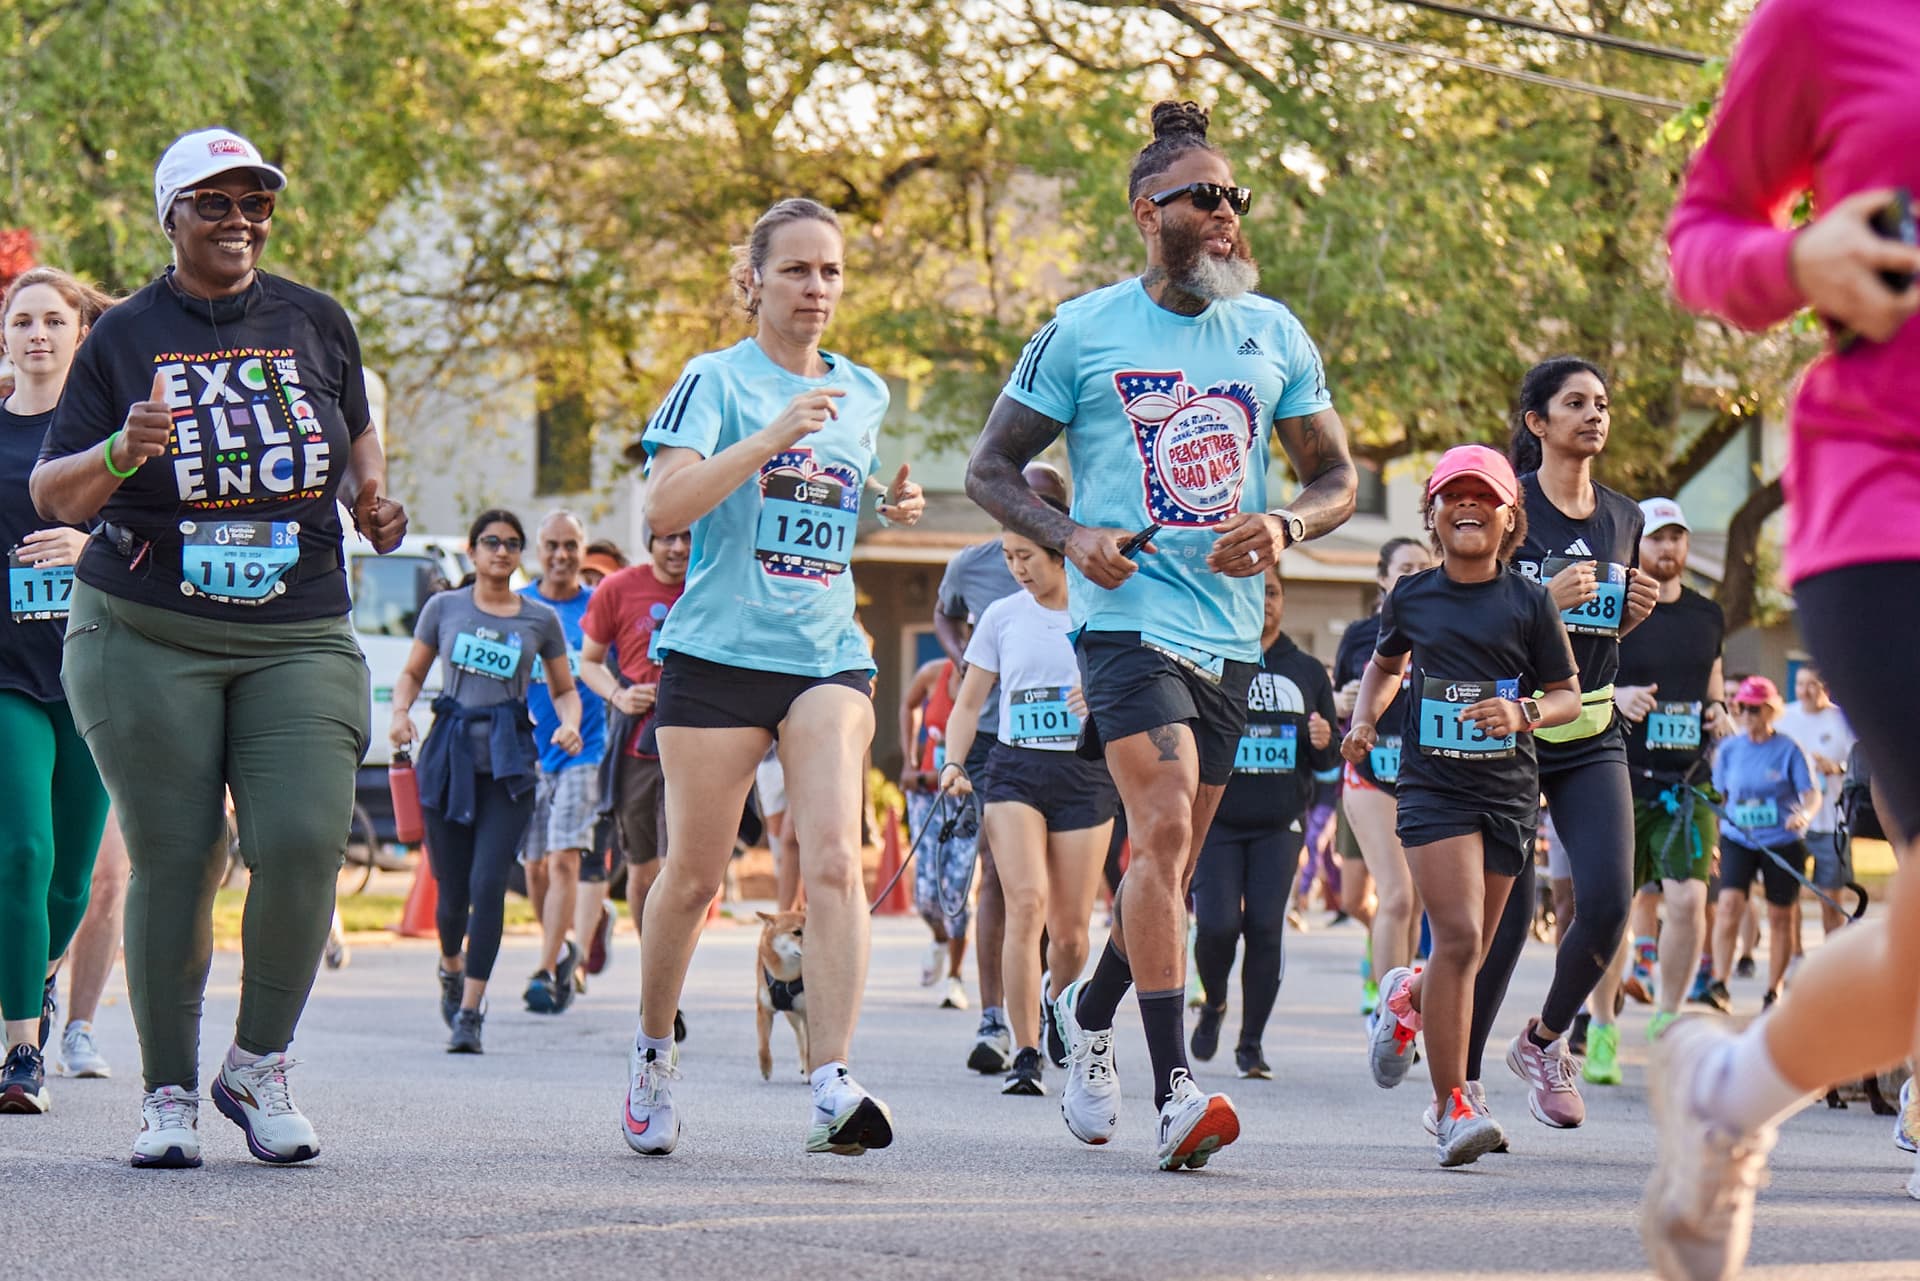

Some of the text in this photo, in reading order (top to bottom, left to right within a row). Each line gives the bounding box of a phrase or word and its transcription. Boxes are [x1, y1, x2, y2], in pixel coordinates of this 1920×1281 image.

[273, 359, 297, 370] THE
[157, 358, 267, 409] EXC
[279, 368, 322, 436] RACE
[176, 403, 290, 454] ELL
[1168, 433, 1237, 465] PEACHTREE
[174, 445, 330, 501] ENCE
[1172, 450, 1240, 489] ROAD RACE
[843, 495, 856, 510] 3K
[275, 531, 294, 545] 3K
[778, 515, 845, 552] 1201
[200, 561, 289, 588] 1197
[463, 644, 511, 671] 1290
[1499, 688, 1516, 699] 3K
[1018, 711, 1068, 731] 1101
[1658, 721, 1695, 739] 1175
[1242, 747, 1288, 765] 1104
